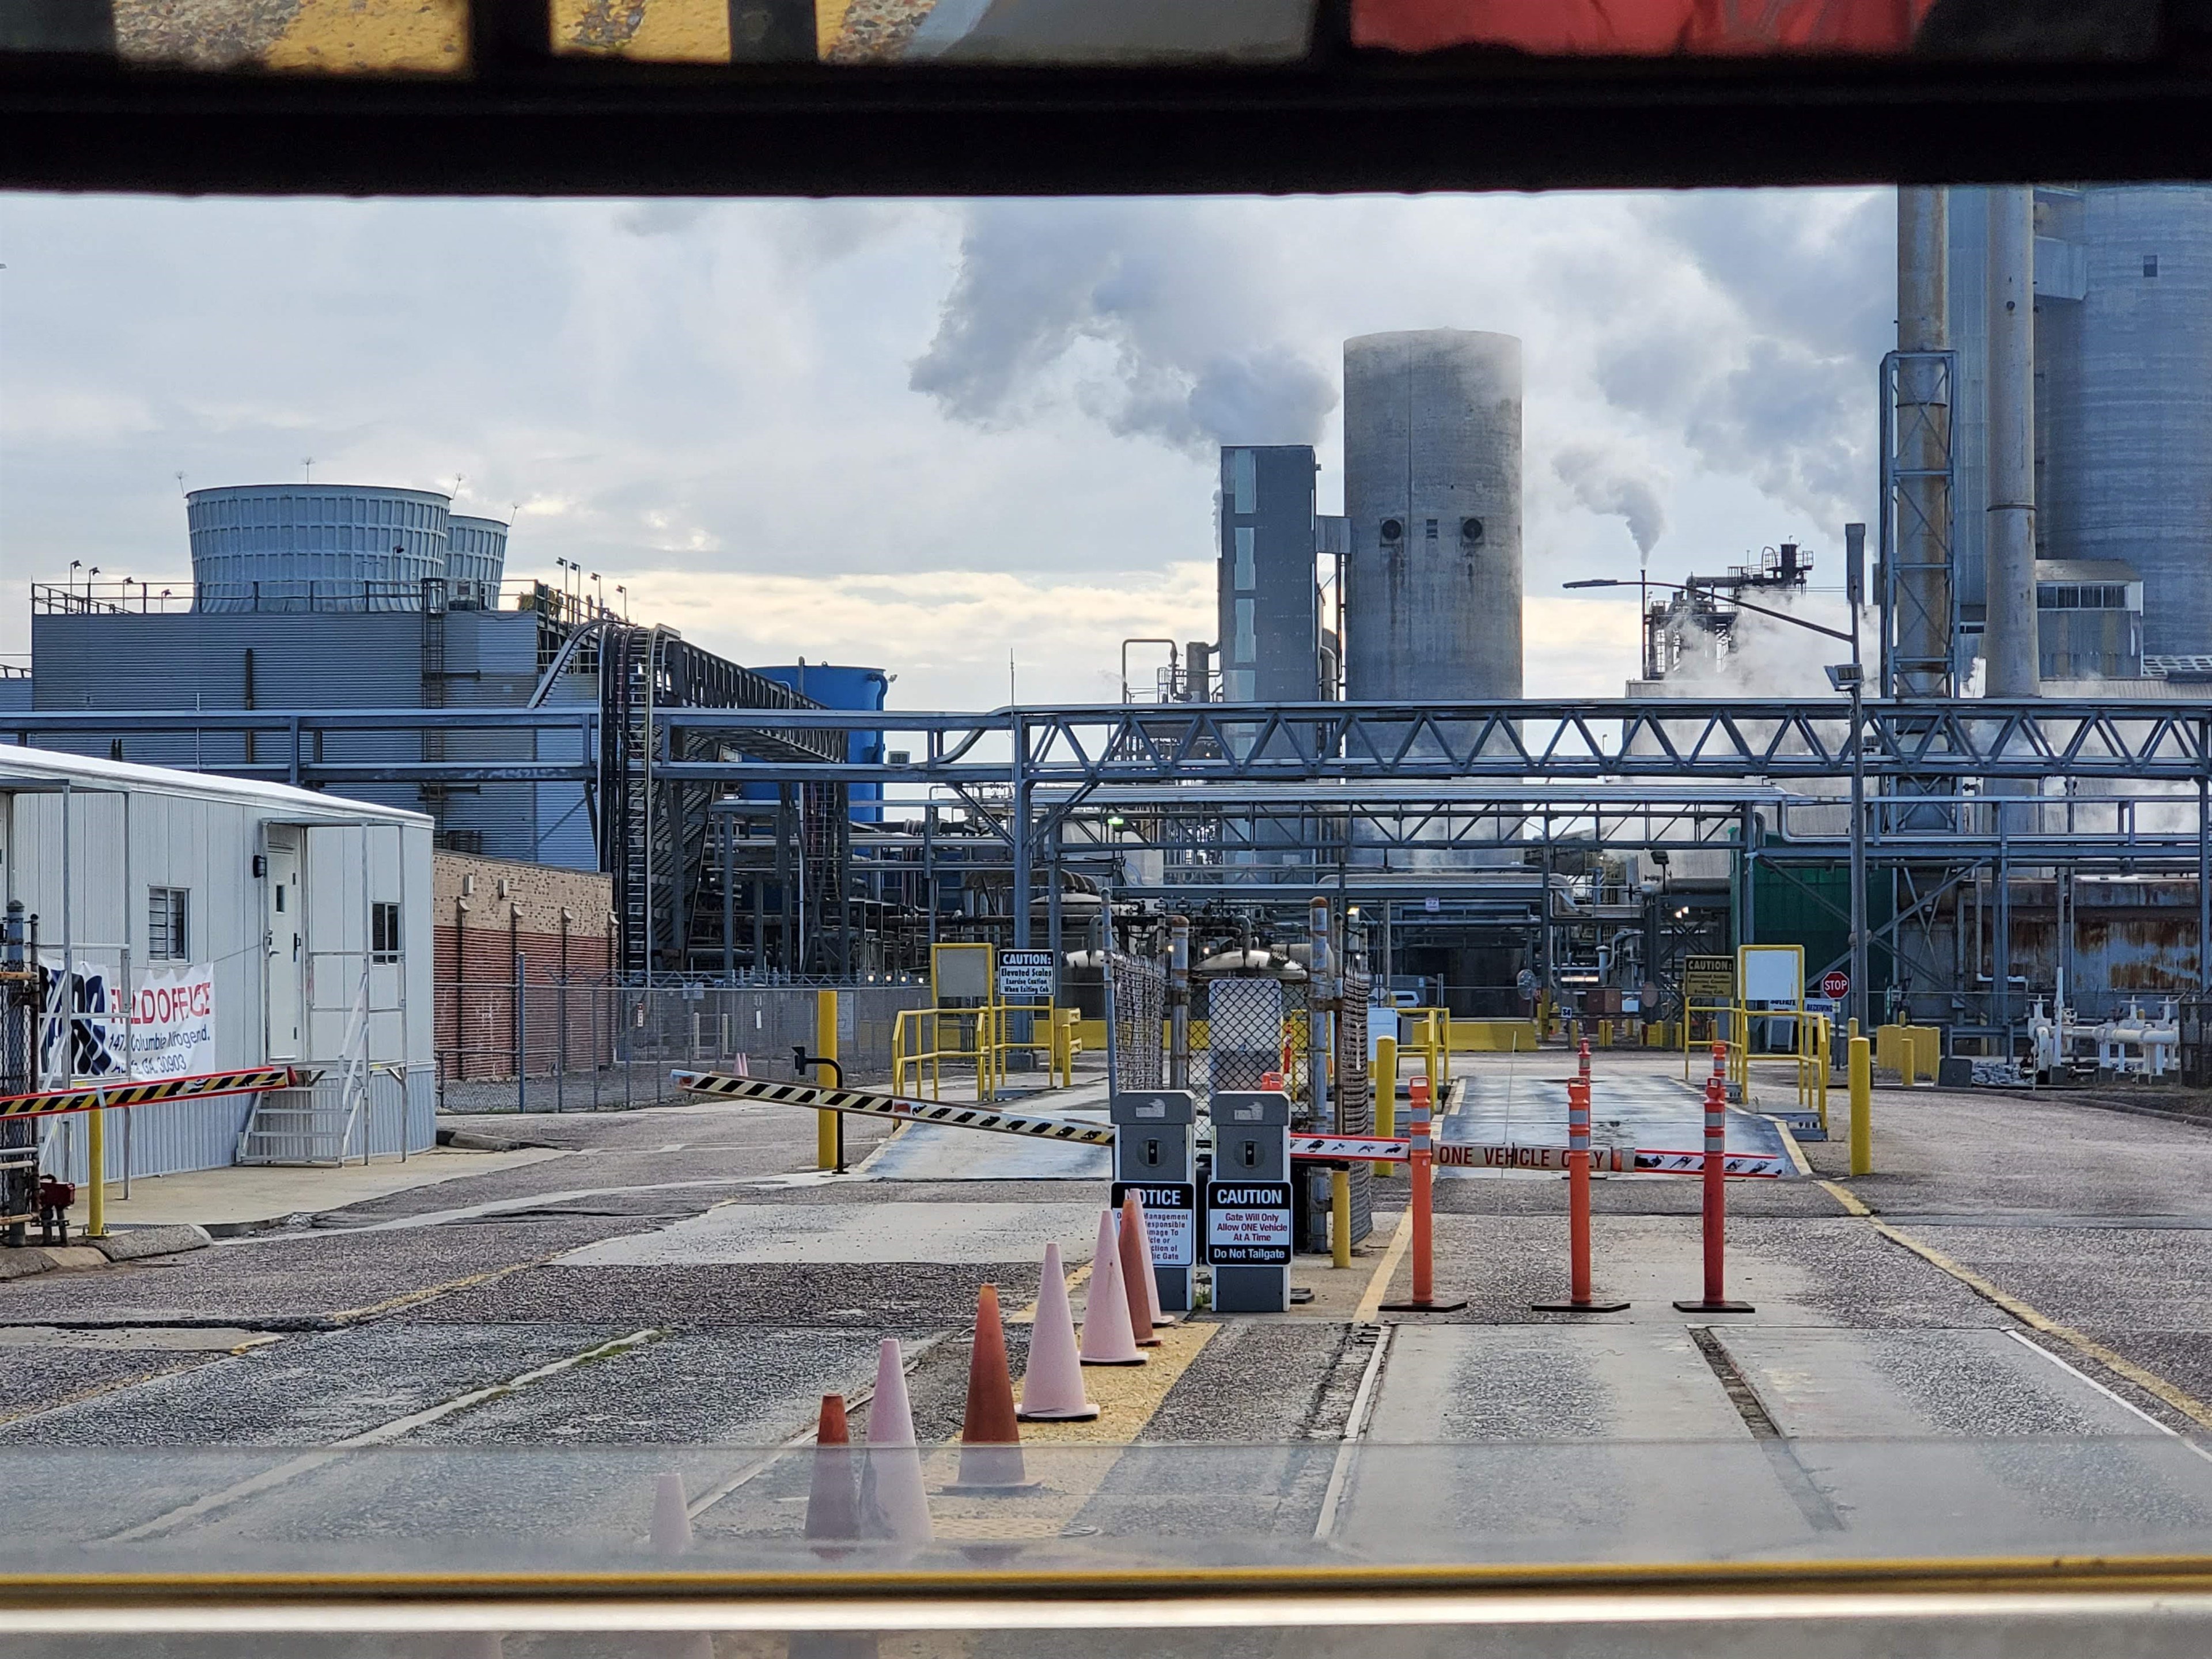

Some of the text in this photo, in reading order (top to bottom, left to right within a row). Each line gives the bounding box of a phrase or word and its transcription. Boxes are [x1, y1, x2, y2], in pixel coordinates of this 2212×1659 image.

[1003, 954, 1051, 964] CAUTION:
[1688, 960, 1732, 970] CAUTION:
[1001, 968, 1052, 977] Elevated Scales
[1824, 980, 1847, 990] STOP
[111, 988, 156, 1024] FILD
[157, 1054, 187, 1073] 30903
[1440, 1146, 1604, 1168] ONE VEHICLE OY
[1217, 1189, 1282, 1204] CAUTION
[1225, 1213, 1279, 1223] Gate Will Only
[1217, 1223, 1287, 1231] Allow ONE Vehicle
[1214, 1248, 1285, 1260] Do Not Tailgate
